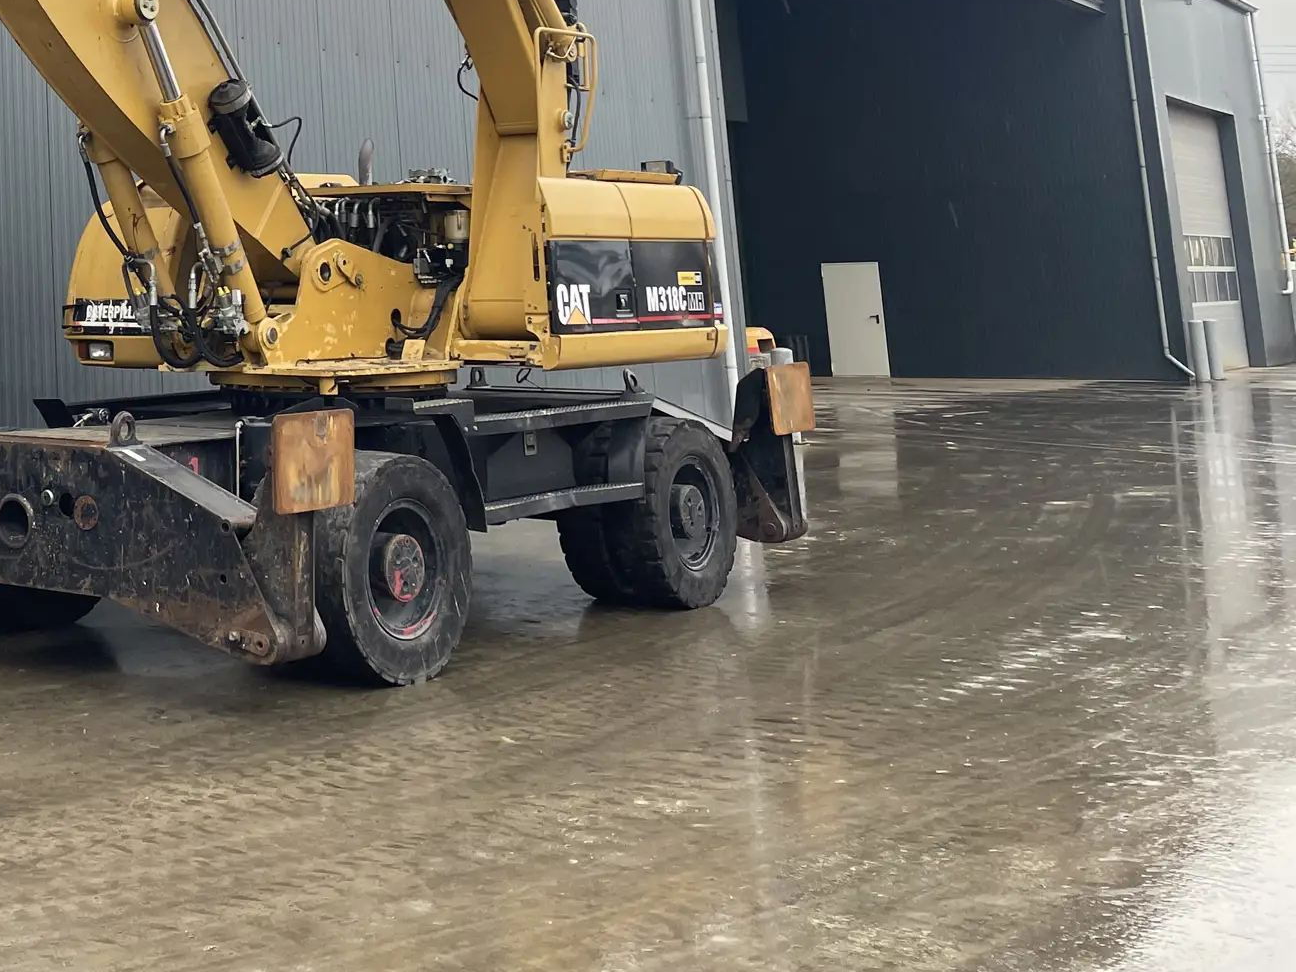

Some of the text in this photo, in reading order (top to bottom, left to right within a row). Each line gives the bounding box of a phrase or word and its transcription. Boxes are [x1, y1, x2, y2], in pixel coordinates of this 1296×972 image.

[86, 304, 135, 319] CATERPILL
[556, 283, 591, 325] CAT
[645, 285, 705, 312] M318C MH
